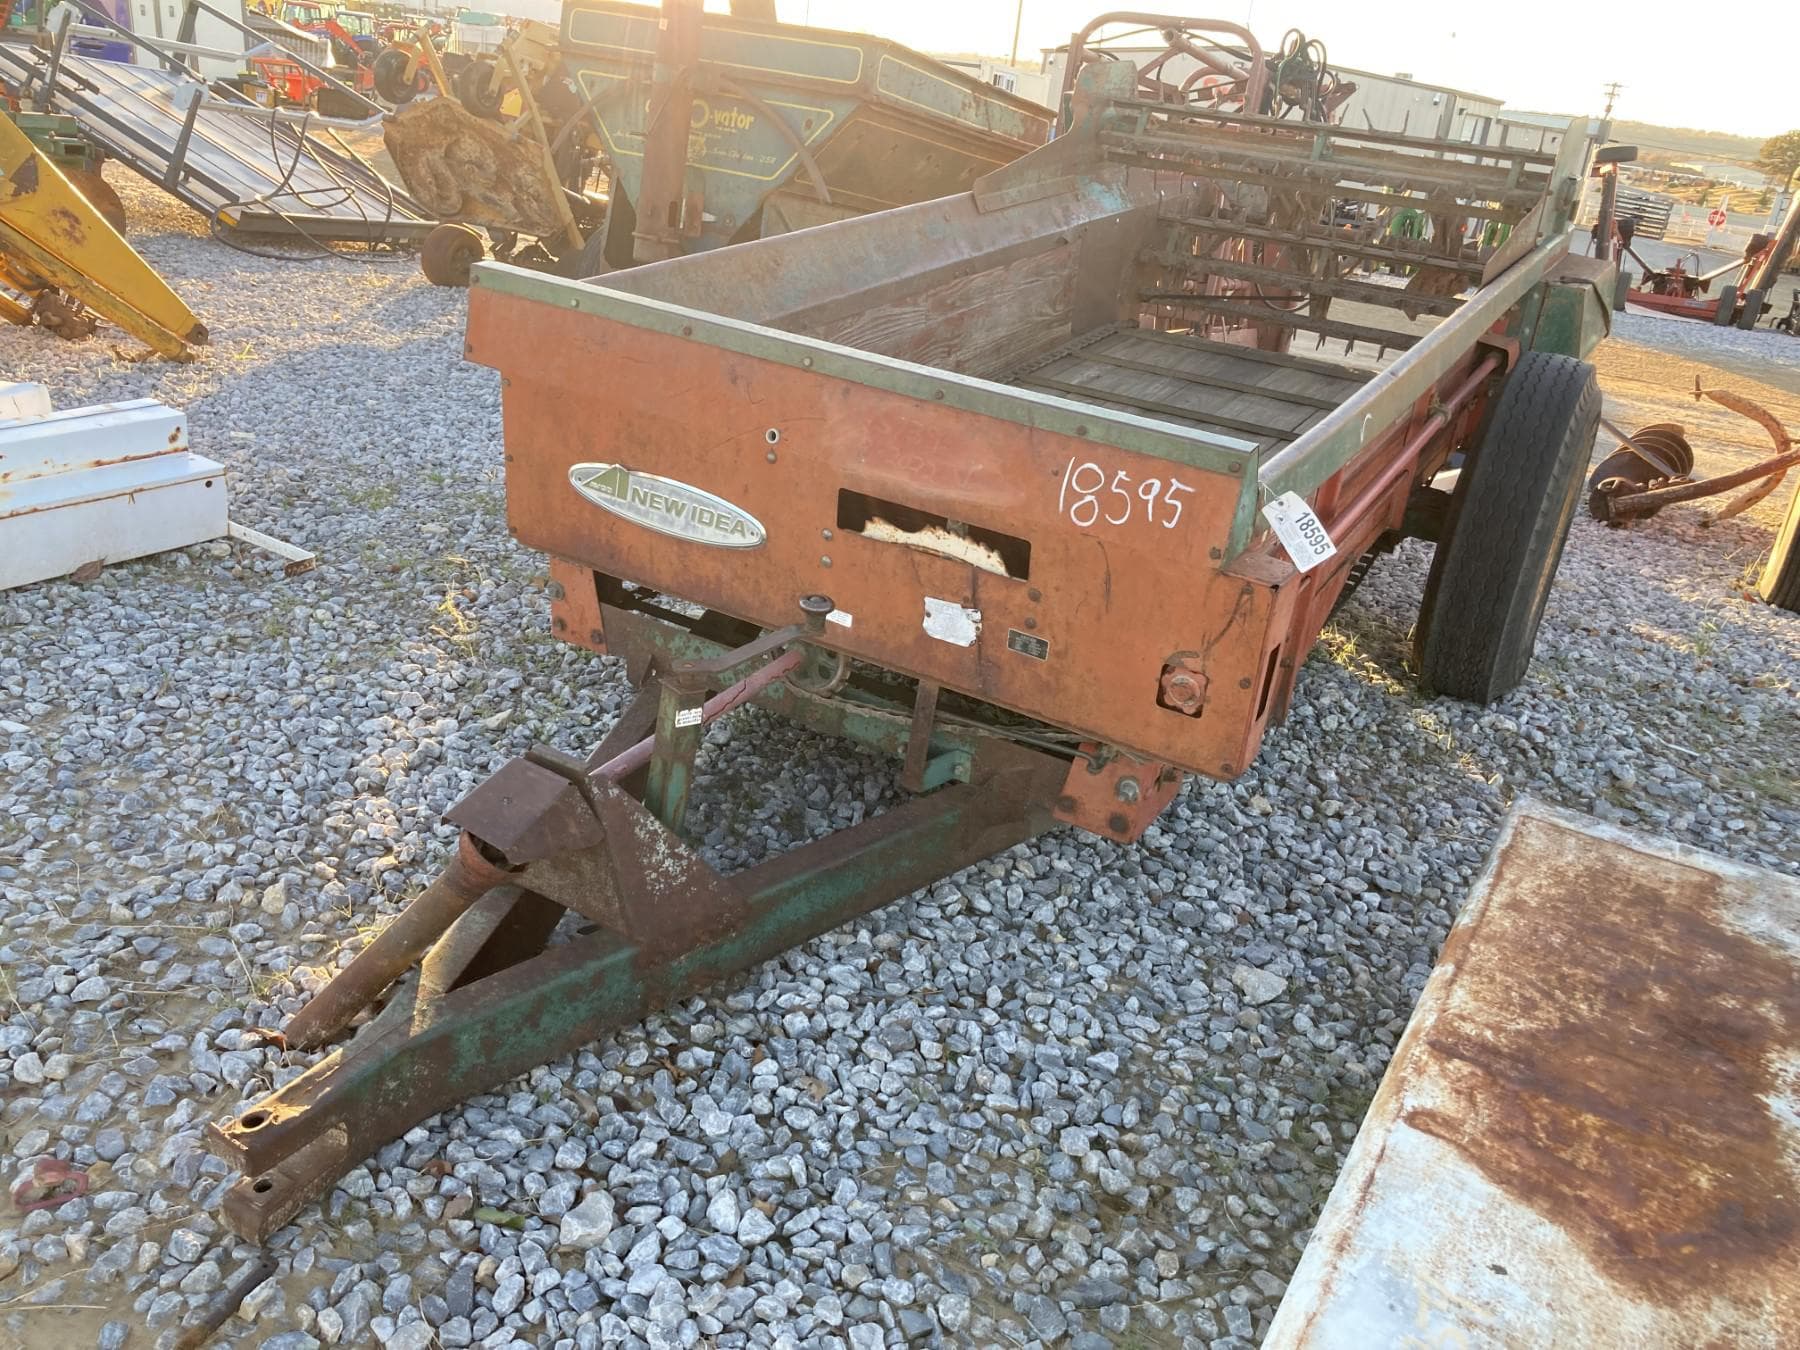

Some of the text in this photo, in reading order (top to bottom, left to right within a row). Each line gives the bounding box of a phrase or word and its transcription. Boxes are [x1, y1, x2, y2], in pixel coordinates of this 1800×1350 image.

[631, 486, 687, 519] NEW
[690, 504, 747, 539] IDEA
[1059, 456, 1196, 529] 18595
[1295, 511, 1331, 555] 18595
